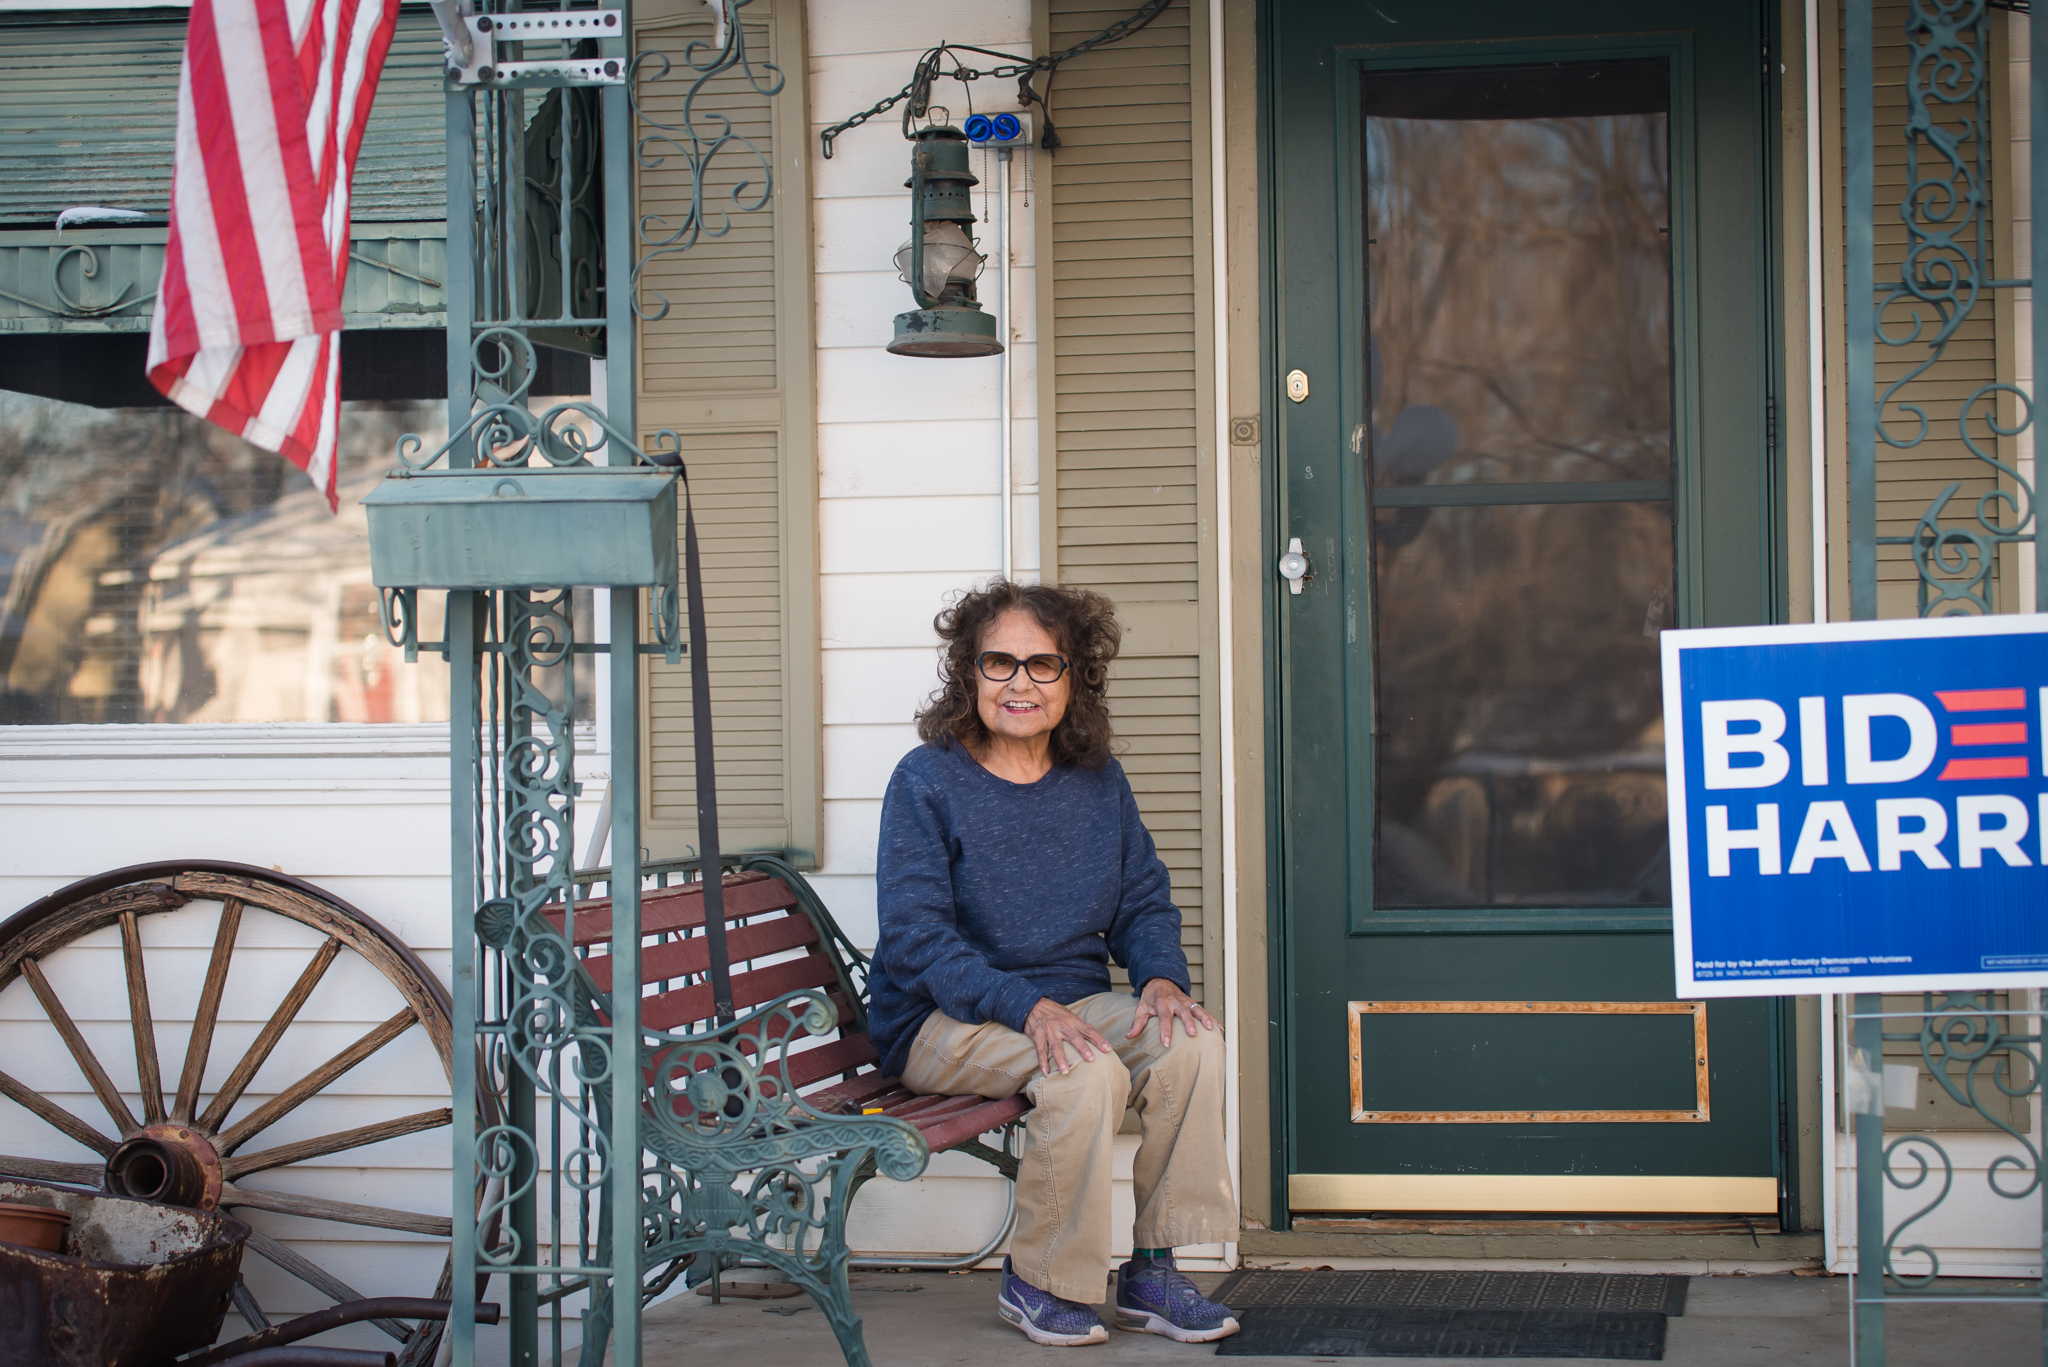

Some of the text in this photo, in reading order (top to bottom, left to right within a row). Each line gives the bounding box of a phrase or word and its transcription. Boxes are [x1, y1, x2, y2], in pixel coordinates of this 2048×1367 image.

[1701, 686, 2048, 790] BIDE
[1695, 955, 1912, 969] Paid for by the Jefferson County Democratic Volunteers
